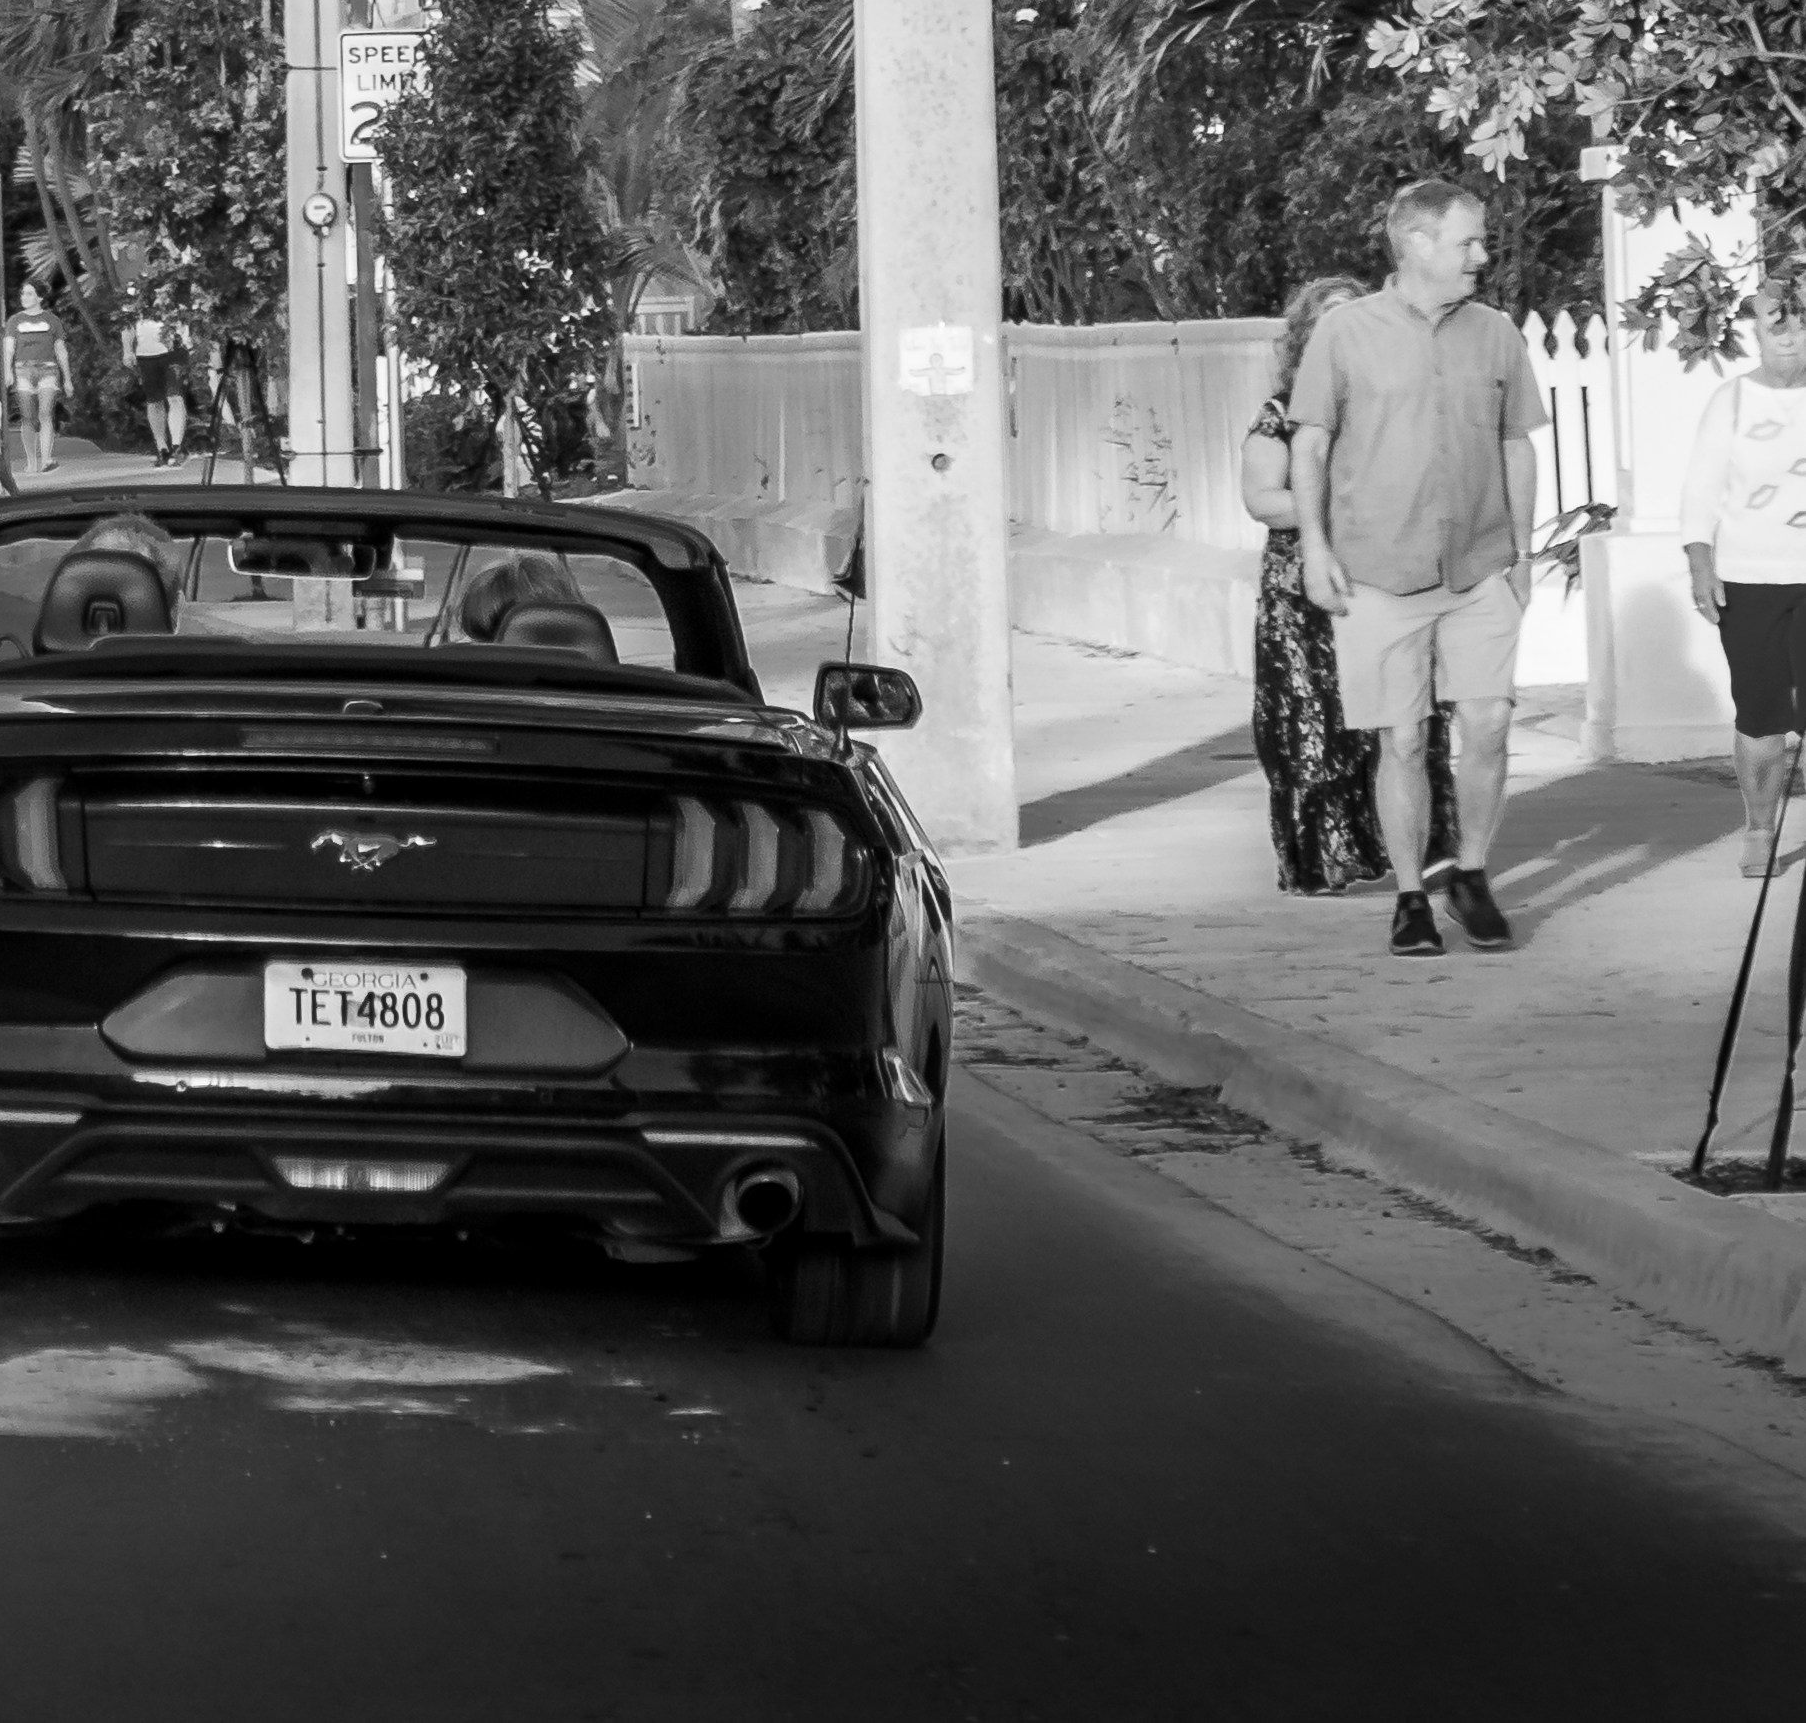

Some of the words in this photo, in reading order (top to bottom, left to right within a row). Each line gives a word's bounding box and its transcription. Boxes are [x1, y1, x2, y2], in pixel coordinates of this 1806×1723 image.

[310, 971, 417, 989] GEORGIA
[289, 987, 445, 1031] TET4808
[351, 1032, 385, 1044] FULTON
